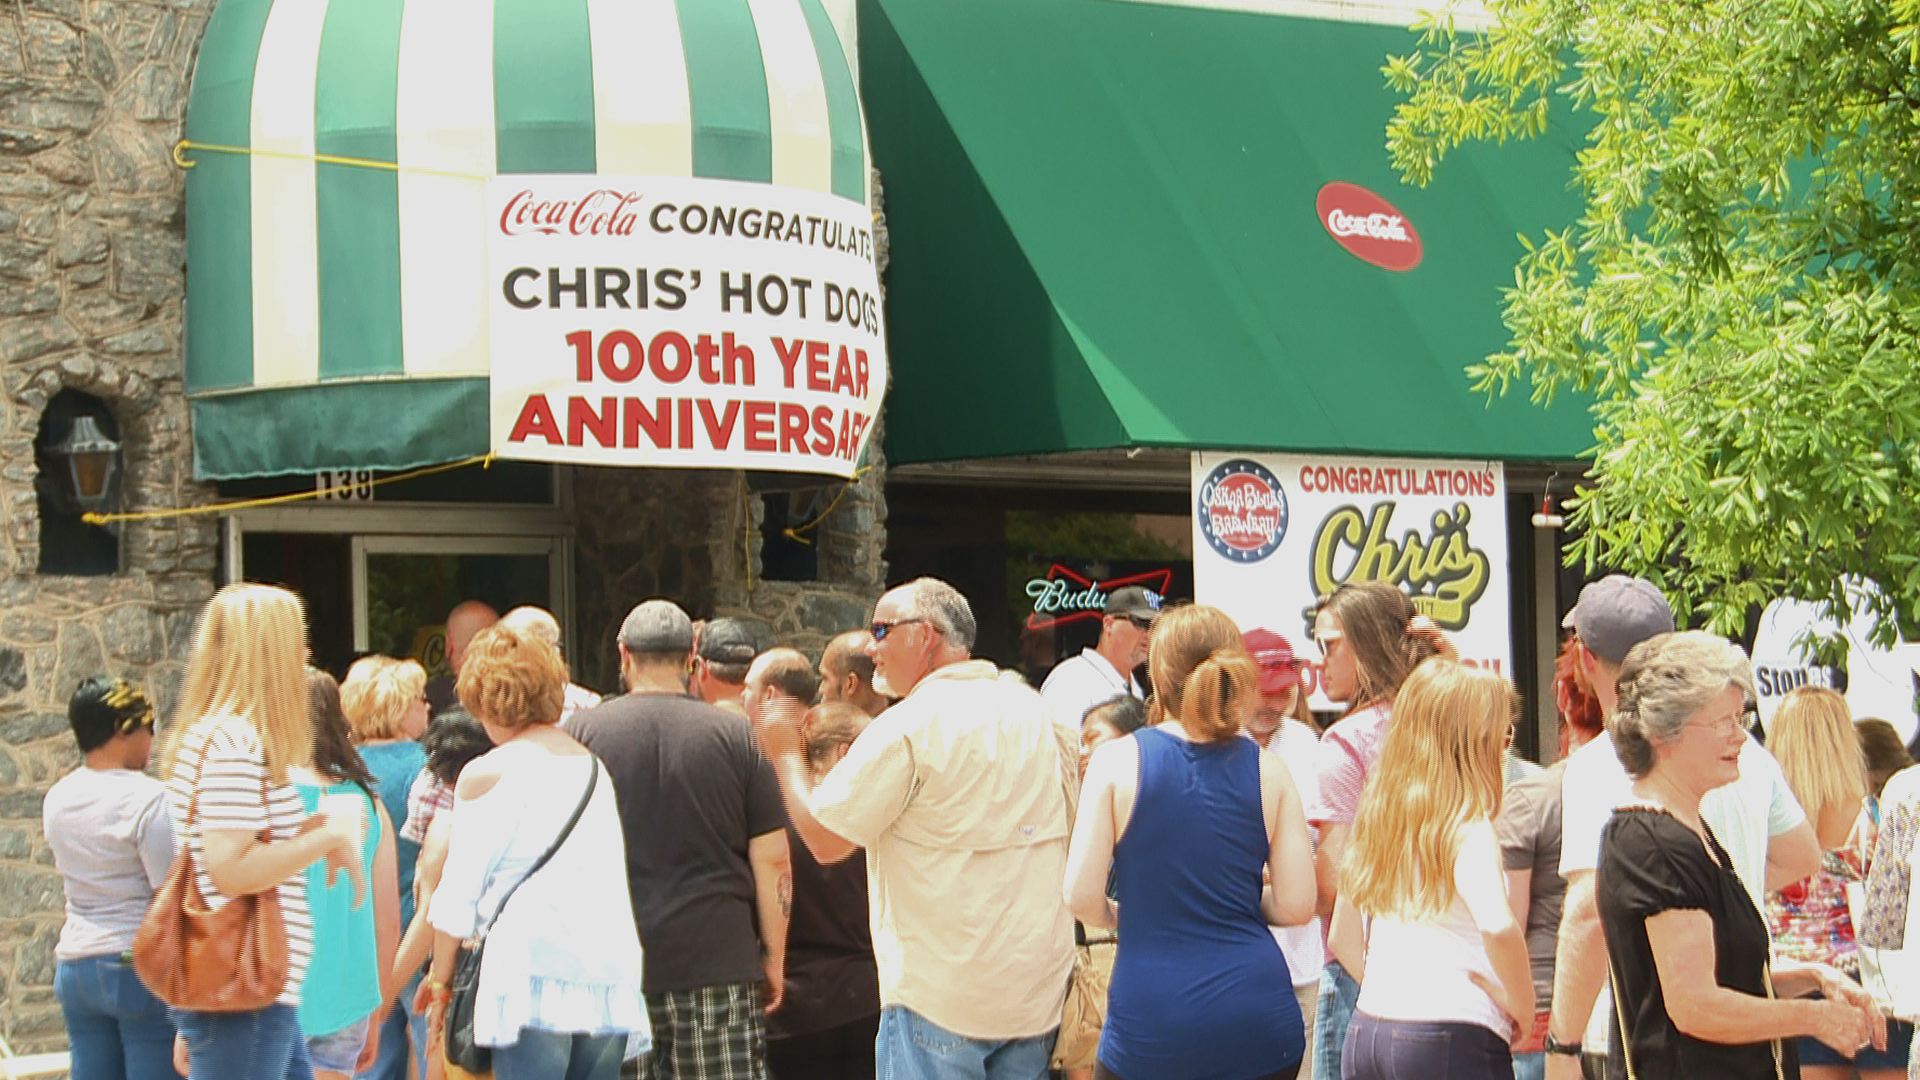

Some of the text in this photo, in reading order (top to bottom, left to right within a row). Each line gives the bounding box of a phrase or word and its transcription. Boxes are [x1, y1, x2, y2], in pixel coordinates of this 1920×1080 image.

[500, 189, 643, 236] Coca-Cola
[1328, 208, 1408, 241] Coca-Cola
[720, 271, 812, 319] HOT
[824, 282, 878, 337] DOGS
[565, 329, 870, 400] 100th YEAR
[320, 469, 371, 500] 138
[1299, 464, 1495, 498] CONGRATULATIONS
